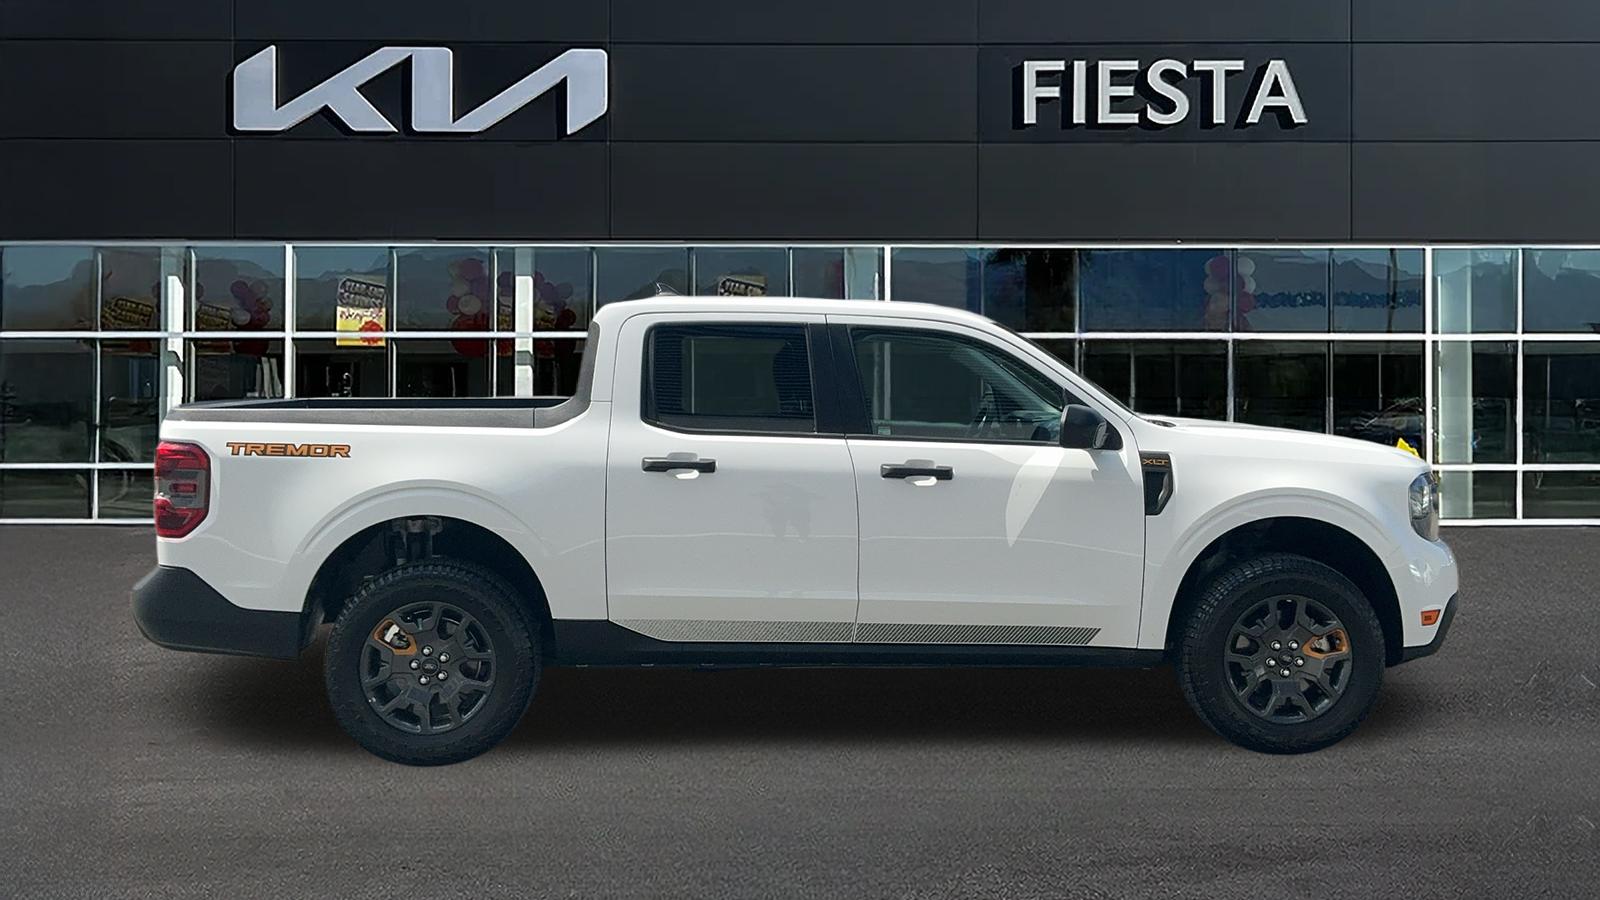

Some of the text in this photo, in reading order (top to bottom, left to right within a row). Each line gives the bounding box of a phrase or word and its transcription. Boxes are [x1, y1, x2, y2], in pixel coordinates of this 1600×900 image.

[233, 44, 608, 135] KIA
[1023, 59, 1308, 125] FIESTA
[226, 442, 351, 458] TREMOR
[1142, 458, 1169, 466] XLT
